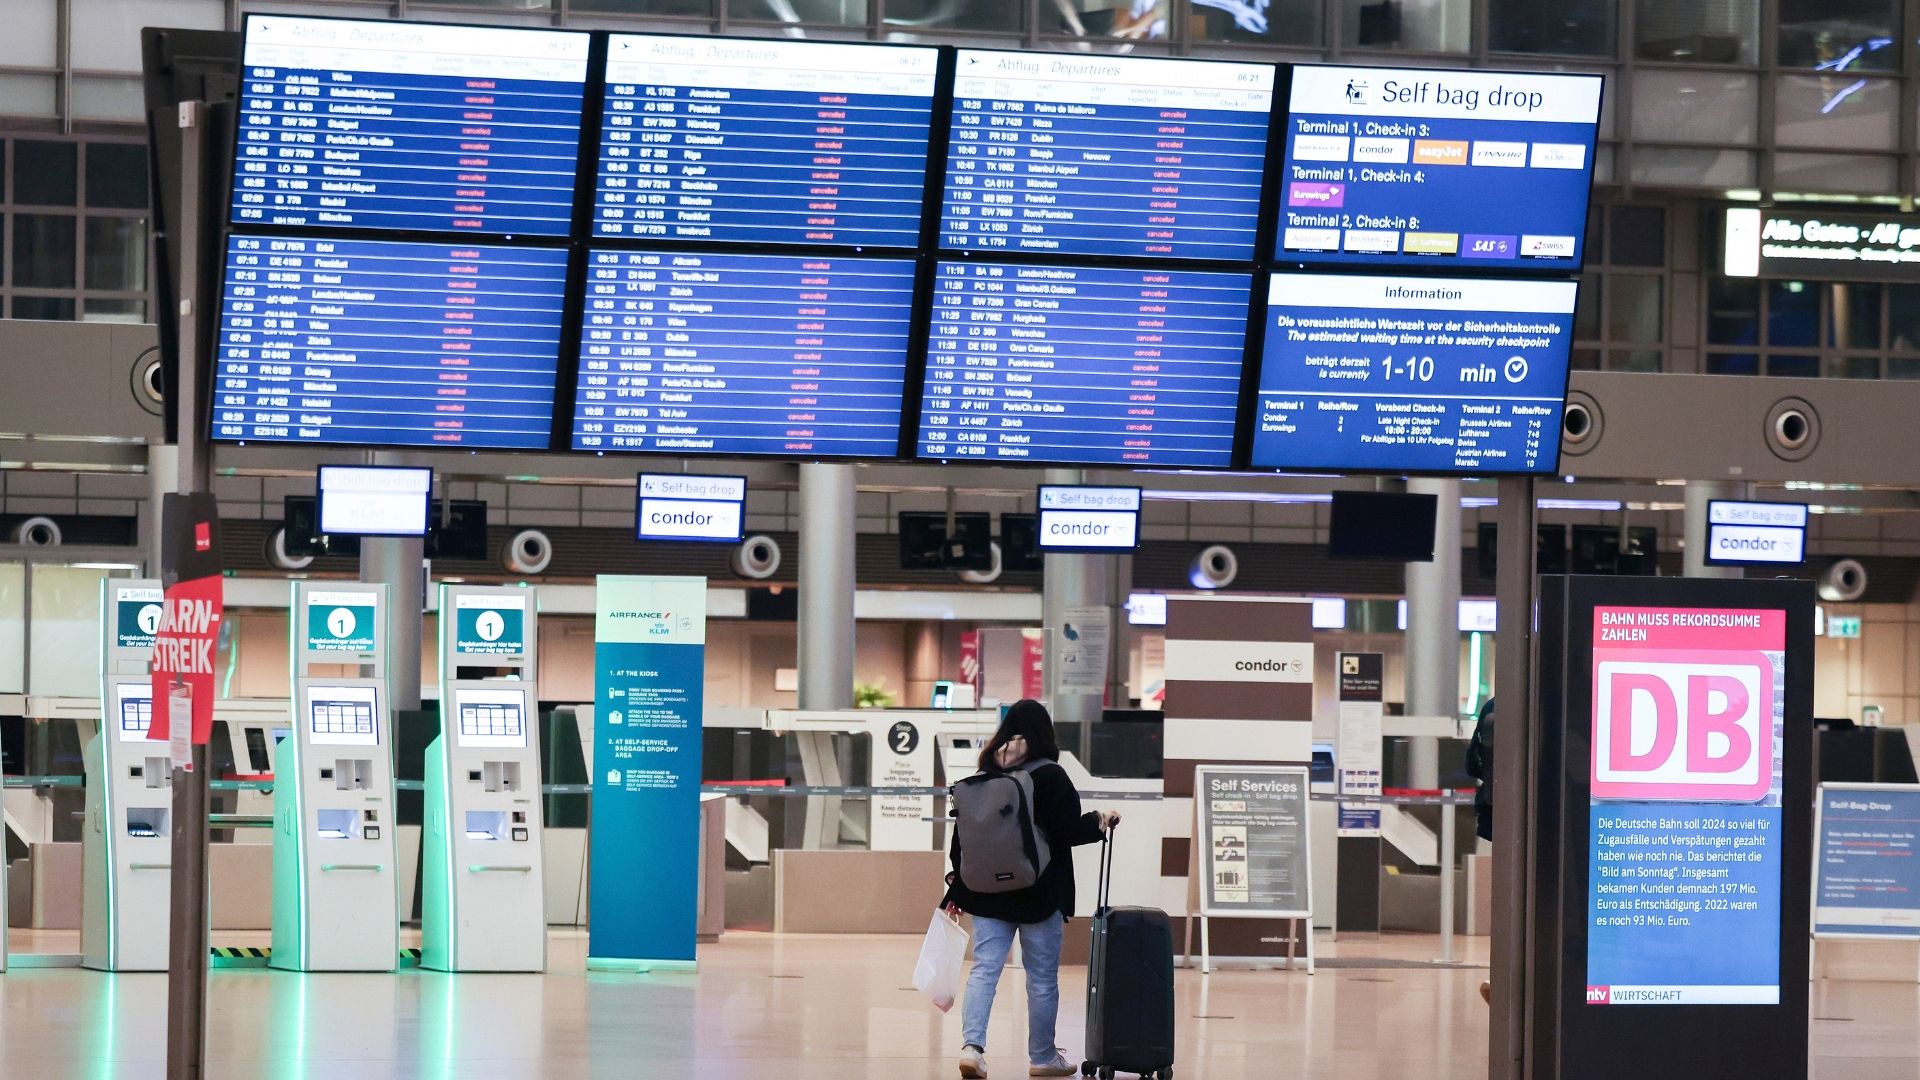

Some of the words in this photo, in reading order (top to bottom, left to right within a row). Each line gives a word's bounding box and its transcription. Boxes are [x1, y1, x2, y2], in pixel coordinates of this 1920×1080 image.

[997, 59, 1039, 73] Abflug
[1051, 61, 1121, 77] Departures
[1383, 81, 1429, 103] Self
[1437, 83, 1479, 110] bag
[1488, 85, 1543, 112] drop
[1297, 120, 1348, 134] Terminal
[1353, 122, 1363, 136] 1,
[1366, 123, 1416, 137] Check-in
[1419, 124, 1429, 137] 3:
[1032, 134, 1053, 143] Dublin
[1360, 144, 1394, 155] condor
[1419, 146, 1461, 159] easyJet
[1029, 165, 1054, 173] Istanbul
[1056, 166, 1078, 175] Airport
[1292, 166, 1344, 181] Terminal
[1348, 169, 1358, 183] 1,
[1361, 169, 1411, 183] Check-in
[1414, 171, 1424, 184] 4:
[1294, 190, 1330, 201] Eurowings
[1288, 213, 1339, 227] Terminal
[1342, 215, 1352, 230] 2,
[1356, 216, 1406, 230] Check-in
[1409, 217, 1420, 230] 8:
[1020, 239, 1059, 248] Amsterdam
[1473, 240, 1496, 252] SAS
[1385, 286, 1462, 300] Information
[1278, 316, 1295, 327] Die
[1297, 318, 1376, 329] voraussichtliche
[1378, 319, 1424, 331] Wartezeit
[1427, 322, 1443, 331] vor
[1445, 321, 1462, 332] der
[1464, 323, 1560, 335] Sicherheitskontrolle
[1288, 330, 1306, 341] The
[1308, 331, 1358, 343] estimated
[1360, 332, 1397, 346] waiting
[1400, 333, 1422, 344] time
[1425, 335, 1434, 345] at
[1437, 335, 1453, 345] the
[1455, 335, 1494, 348] security
[1496, 337, 1550, 349] checkpoint
[1306, 356, 1338, 368] beträgt
[1340, 357, 1370, 367] derzeit
[1320, 369, 1328, 379] is
[1330, 369, 1369, 381] currently
[1382, 355, 1434, 382] 1-10
[1460, 365, 1496, 383] min
[1265, 401, 1298, 410] Terminal
[1318, 402, 1359, 412] Reihe/Row
[1376, 404, 1411, 413] Vorabend
[1462, 405, 1495, 415] Terminal
[1512, 406, 1552, 417] Reihe/Row
[1264, 414, 1287, 422] Condor
[1339, 416, 1343, 424] 2
[1262, 424, 1296, 434] Eurowings
[1338, 425, 1342, 434] 4
[662, 482, 682, 493] Self
[686, 484, 706, 495] bag
[710, 484, 735, 496] drop
[1061, 494, 1081, 504] Self
[1084, 495, 1103, 506] bag
[1106, 495, 1131, 506] drop
[652, 511, 713, 525] condor
[1730, 508, 1749, 519] Self
[1752, 510, 1770, 521] bag
[1773, 511, 1797, 522] drop
[1051, 521, 1110, 535] condor
[1720, 536, 1777, 550] condor
[148, 616, 154, 630] 1
[338, 620, 343, 633] 1
[1602, 613, 1634, 625] BAHN
[1638, 614, 1669, 626] MUSS
[1672, 615, 1760, 627] REKORDSUMME
[486, 623, 492, 636] 1
[1602, 629, 1647, 641] ZAHLEN
[153, 637, 213, 674] STREIK
[1235, 659, 1287, 672] condor
[896, 724, 911, 732] Step
[1609, 673, 1751, 773] DB
[897, 732, 910, 751] 2
[1212, 780, 1238, 791] Self
[1241, 780, 1297, 792] Services
[1599, 819, 1613, 829] Die
[1615, 819, 1656, 829] Deutsche
[1660, 819, 1681, 829] Bahn
[1684, 819, 1700, 830] soll
[1703, 819, 1725, 830] 2024
[1728, 822, 1737, 830] so
[1740, 820, 1755, 830] viel
[1758, 820, 1769, 830] für
[1598, 834, 1649, 846] Zugausfälle
[1652, 835, 1668, 845] und
[1671, 835, 1731, 847] Verspätungen
[1734, 836, 1765, 847] gezahlt
[1598, 851, 1625, 861] haben
[1628, 852, 1643, 861] wie
[1646, 852, 1666, 861] noch
[1669, 852, 1685, 862] nie.
[1688, 852, 1704, 862] Das
[1707, 852, 1746, 862] berichtet
[1749, 852, 1762, 862] die
[1598, 867, 1619, 877] "Bild
[1622, 869, 1635, 877] am
[1638, 867, 1679, 879] Sonntag".
[1682, 868, 1728, 879] Insgesamt
[1598, 883, 1638, 893] bekamen
[1641, 883, 1674, 893] Kunden
[1677, 883, 1717, 894] demnach
[1720, 884, 1737, 894] 197
[1740, 884, 1757, 894] Mio.
[1597, 900, 1617, 909] Euro
[1620, 899, 1632, 909] als
[1635, 899, 1702, 912] Entschädigung.
[1705, 900, 1727, 910] 2022
[1730, 902, 1757, 910] waren
[1597, 917, 1607, 925] es
[1610, 915, 1630, 925] noch
[1633, 916, 1644, 925] 93
[1648, 916, 1665, 926] Mio.
[1668, 916, 1690, 926] Euro.
[1587, 988, 1607, 1001] ntv
[1614, 990, 1682, 1001] WIRTSCHAFT
